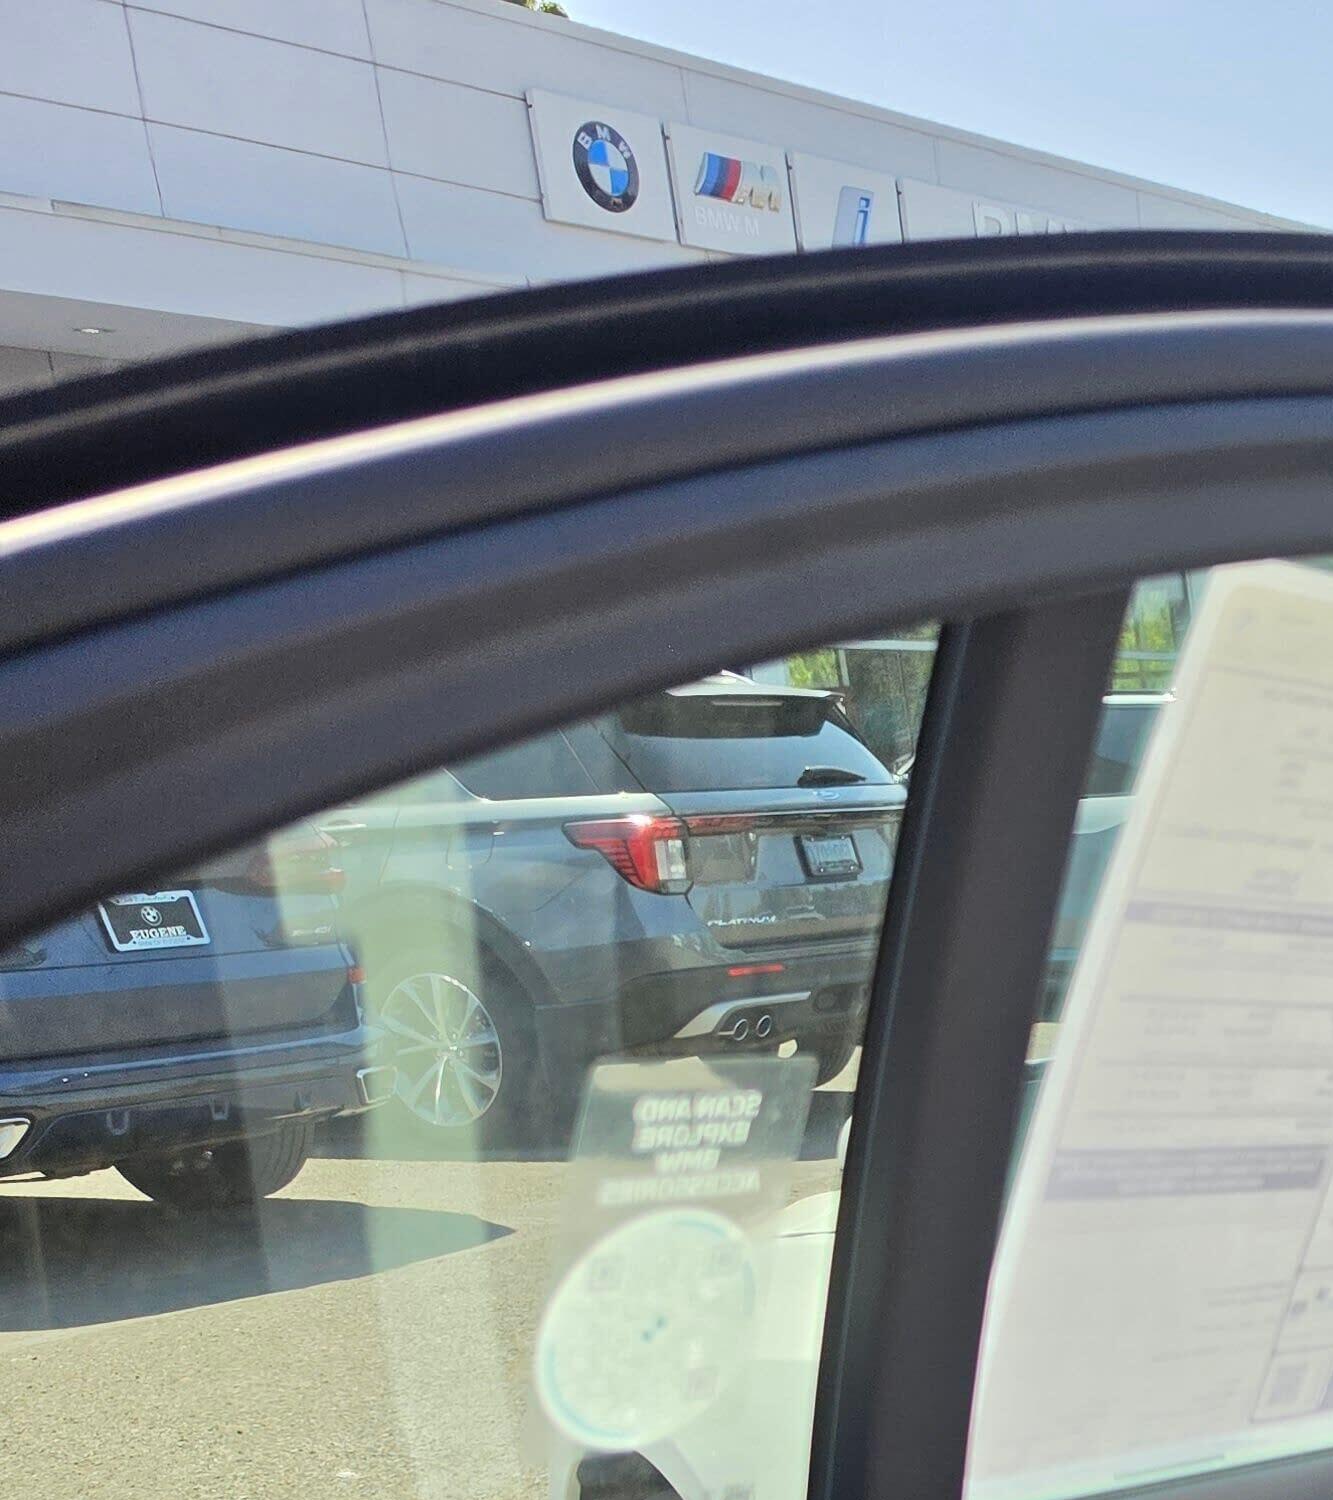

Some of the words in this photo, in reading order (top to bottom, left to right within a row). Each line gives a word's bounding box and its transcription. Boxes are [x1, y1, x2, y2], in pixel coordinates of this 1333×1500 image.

[577, 124, 632, 160] BMW
[695, 208, 739, 233] BMW
[744, 215, 762, 238] M
[129, 925, 187, 939] EUGENE
[706, 914, 777, 928] PLATINUM
